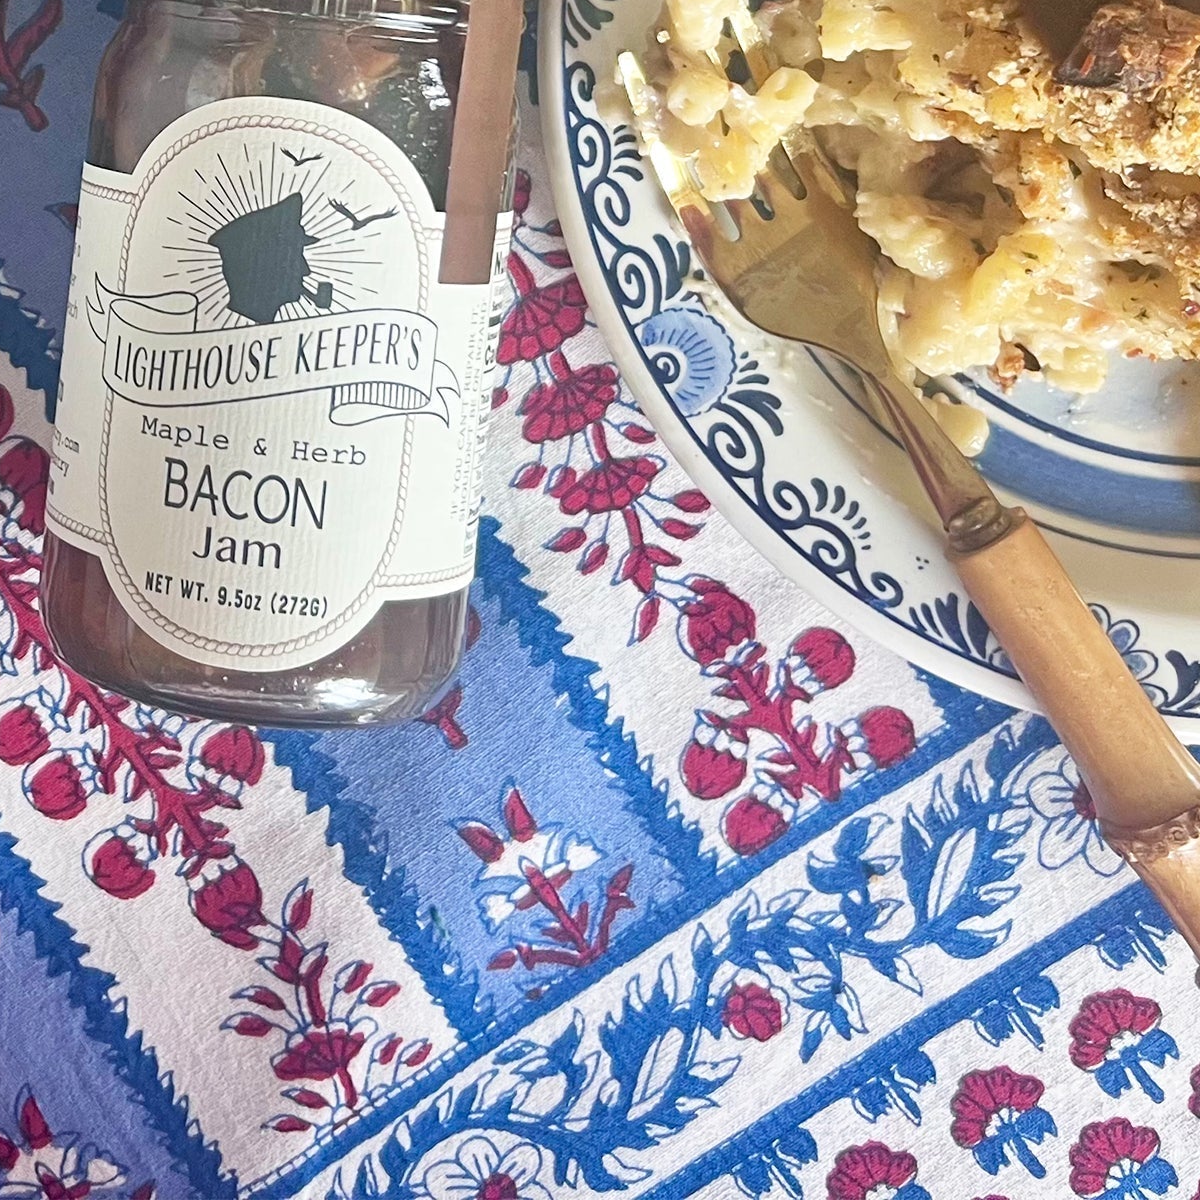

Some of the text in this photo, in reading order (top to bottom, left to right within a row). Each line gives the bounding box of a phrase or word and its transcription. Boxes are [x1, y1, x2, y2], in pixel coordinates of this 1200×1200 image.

[113, 334, 284, 392] LIGHTHOUSE
[294, 322, 422, 376] KEEPER'S
[140, 414, 367, 466] Maple & Herb
[163, 456, 328, 530] BACON
[192, 526, 282, 569] Jam
[145, 571, 173, 595] NET
[180, 578, 209, 603] WT.
[270, 592, 328, 619] (272G)
